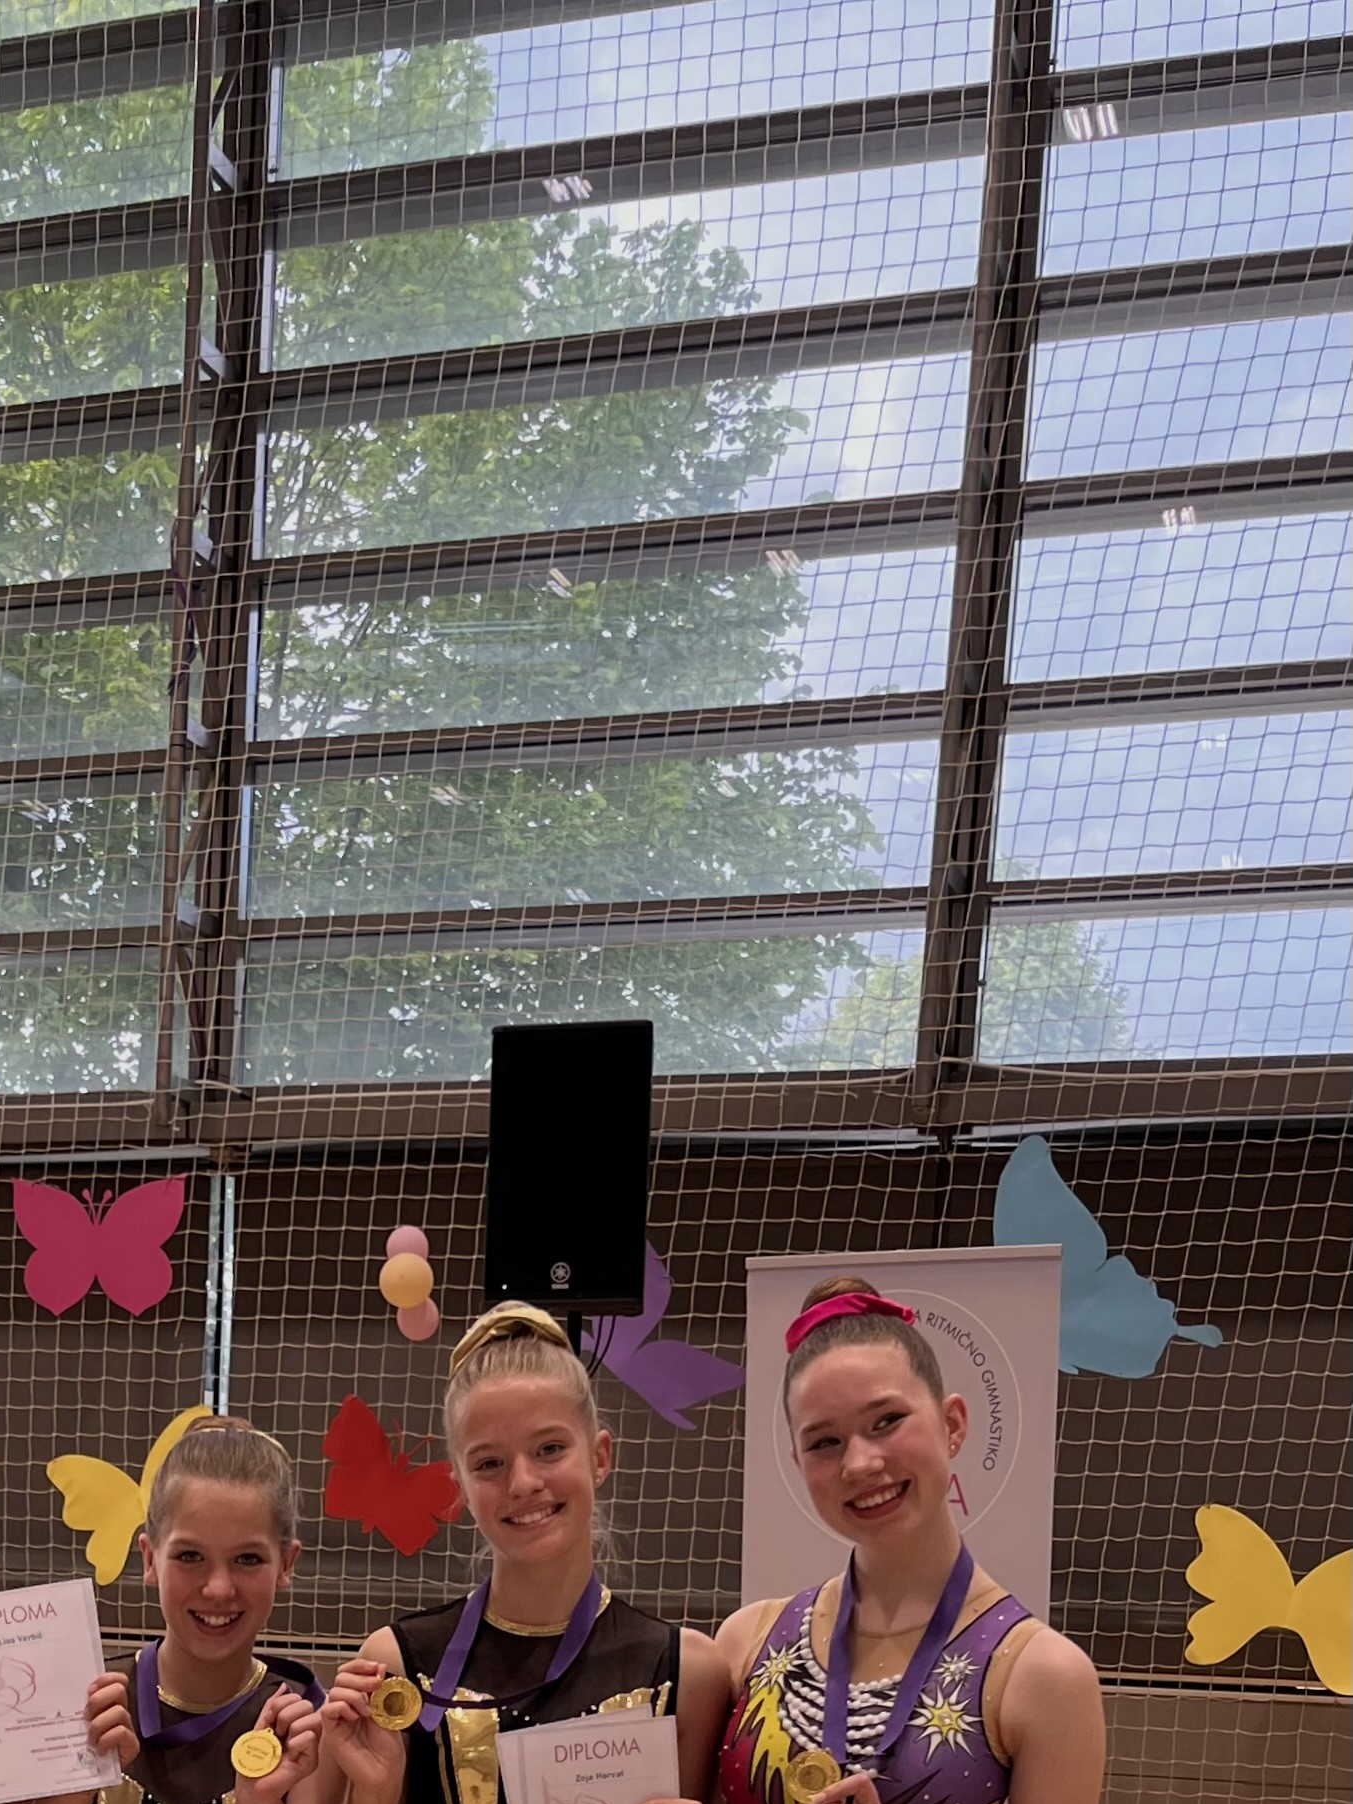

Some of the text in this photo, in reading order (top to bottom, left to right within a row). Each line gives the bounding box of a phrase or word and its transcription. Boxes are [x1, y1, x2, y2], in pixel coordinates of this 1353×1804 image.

[926, 1312, 986, 1367] RITMIČNO
[981, 1369, 1003, 1471] GIMNASTIKO
[554, 1738, 641, 1763] DIPLOMA
